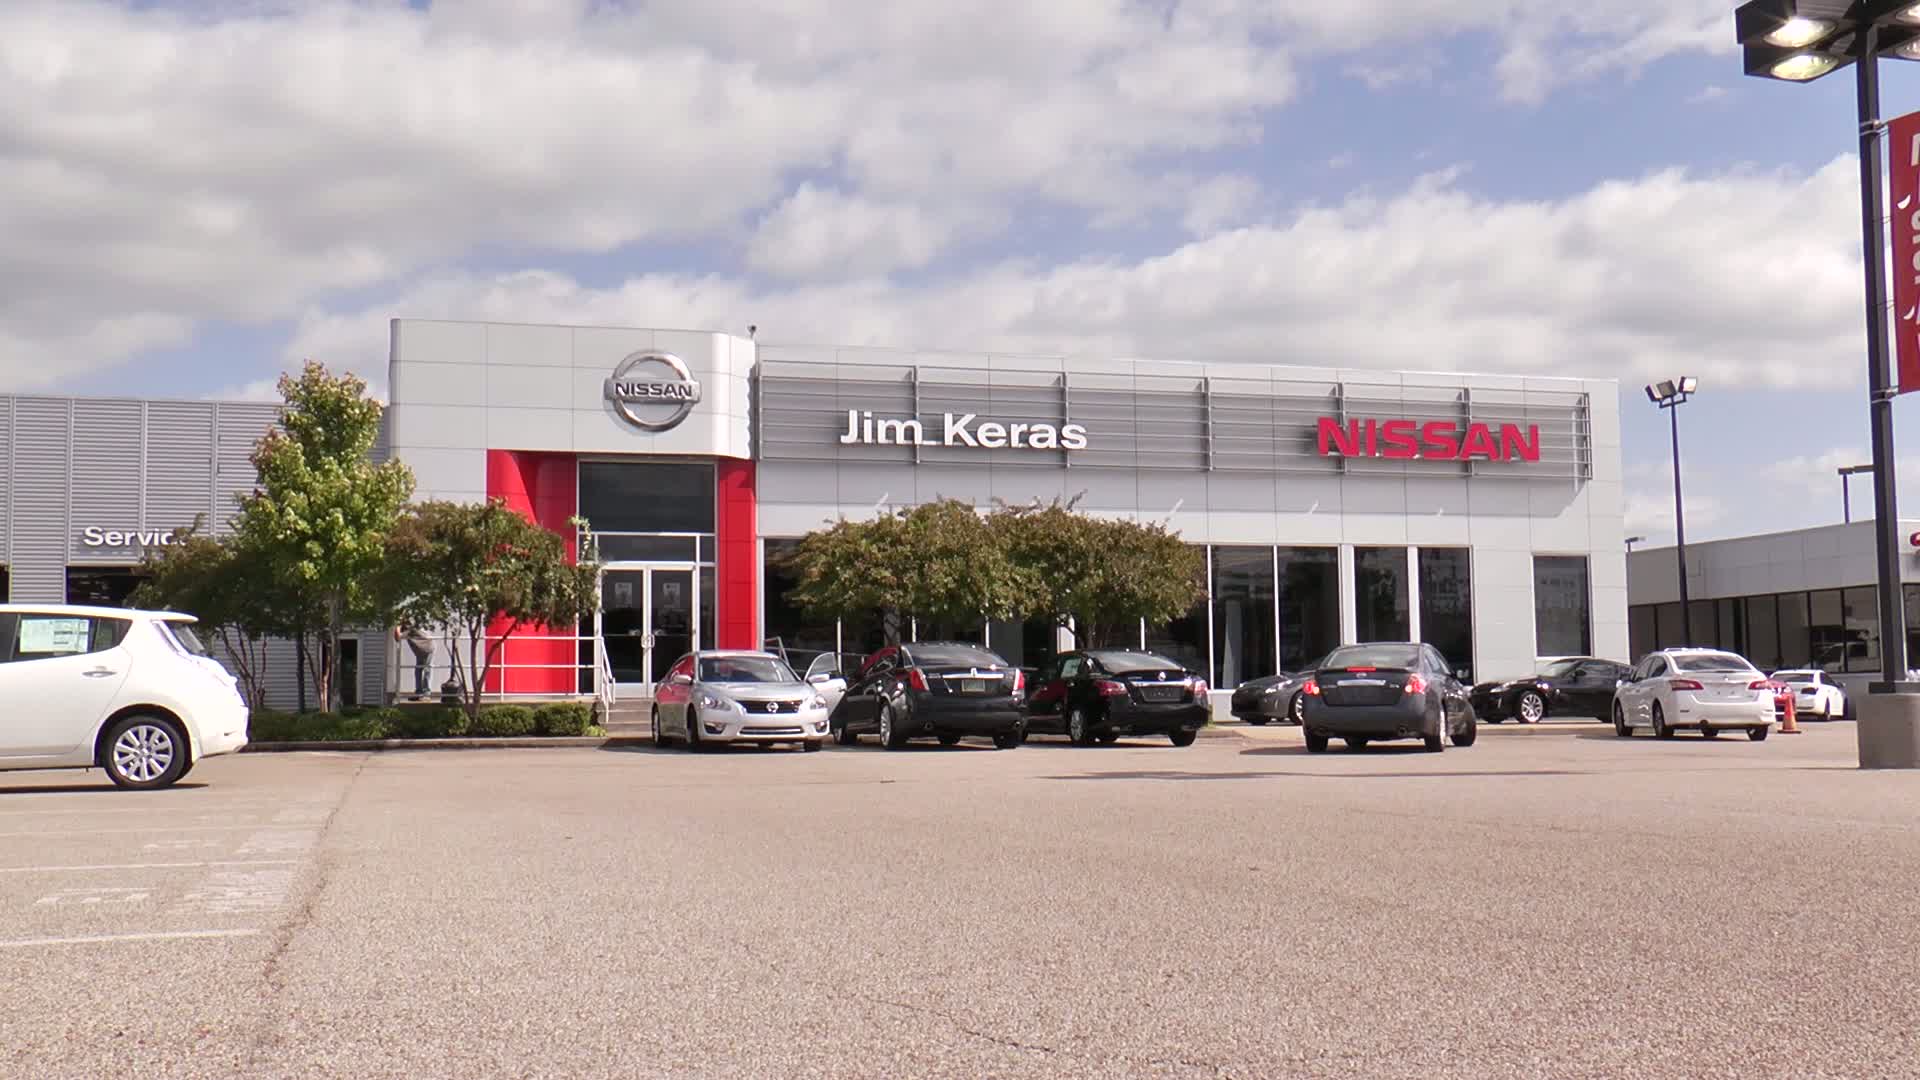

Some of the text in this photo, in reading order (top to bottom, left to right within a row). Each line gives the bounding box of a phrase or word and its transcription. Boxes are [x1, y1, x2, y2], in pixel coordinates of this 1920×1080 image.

[614, 382, 692, 399] NISSAN
[839, 409, 1088, 451] Jim Keras
[1317, 417, 1539, 462] NISSAN
[83, 526, 188, 546] Servic
